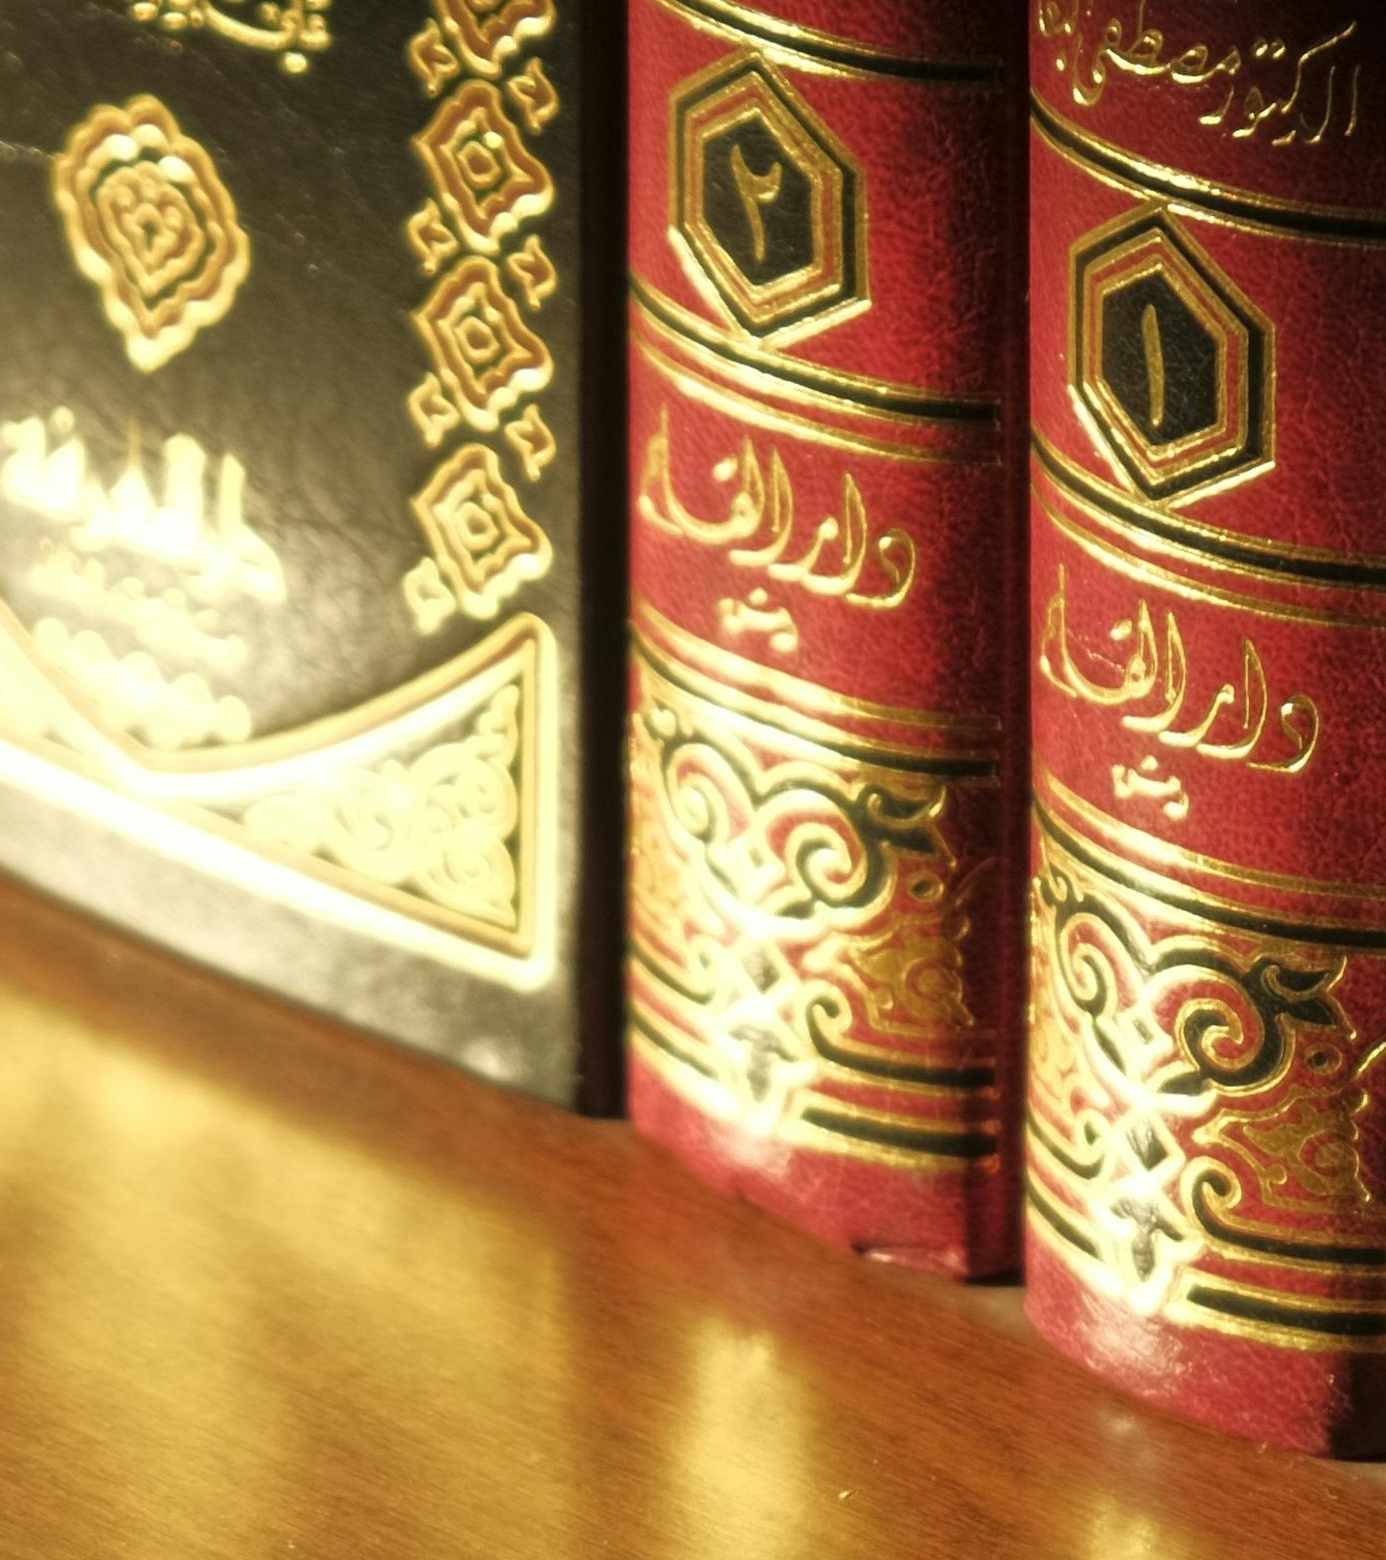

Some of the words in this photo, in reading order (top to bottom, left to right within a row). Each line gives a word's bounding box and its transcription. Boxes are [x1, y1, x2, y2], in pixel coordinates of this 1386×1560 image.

[1199, 18, 1362, 146] الدكتور
[727, 142, 784, 266] ٢
[1139, 302, 1168, 429] ١
[637, 405, 788, 570] القلم
[767, 470, 920, 611] دار
[1039, 562, 1187, 738] القلم
[1169, 636, 1323, 775] دار
